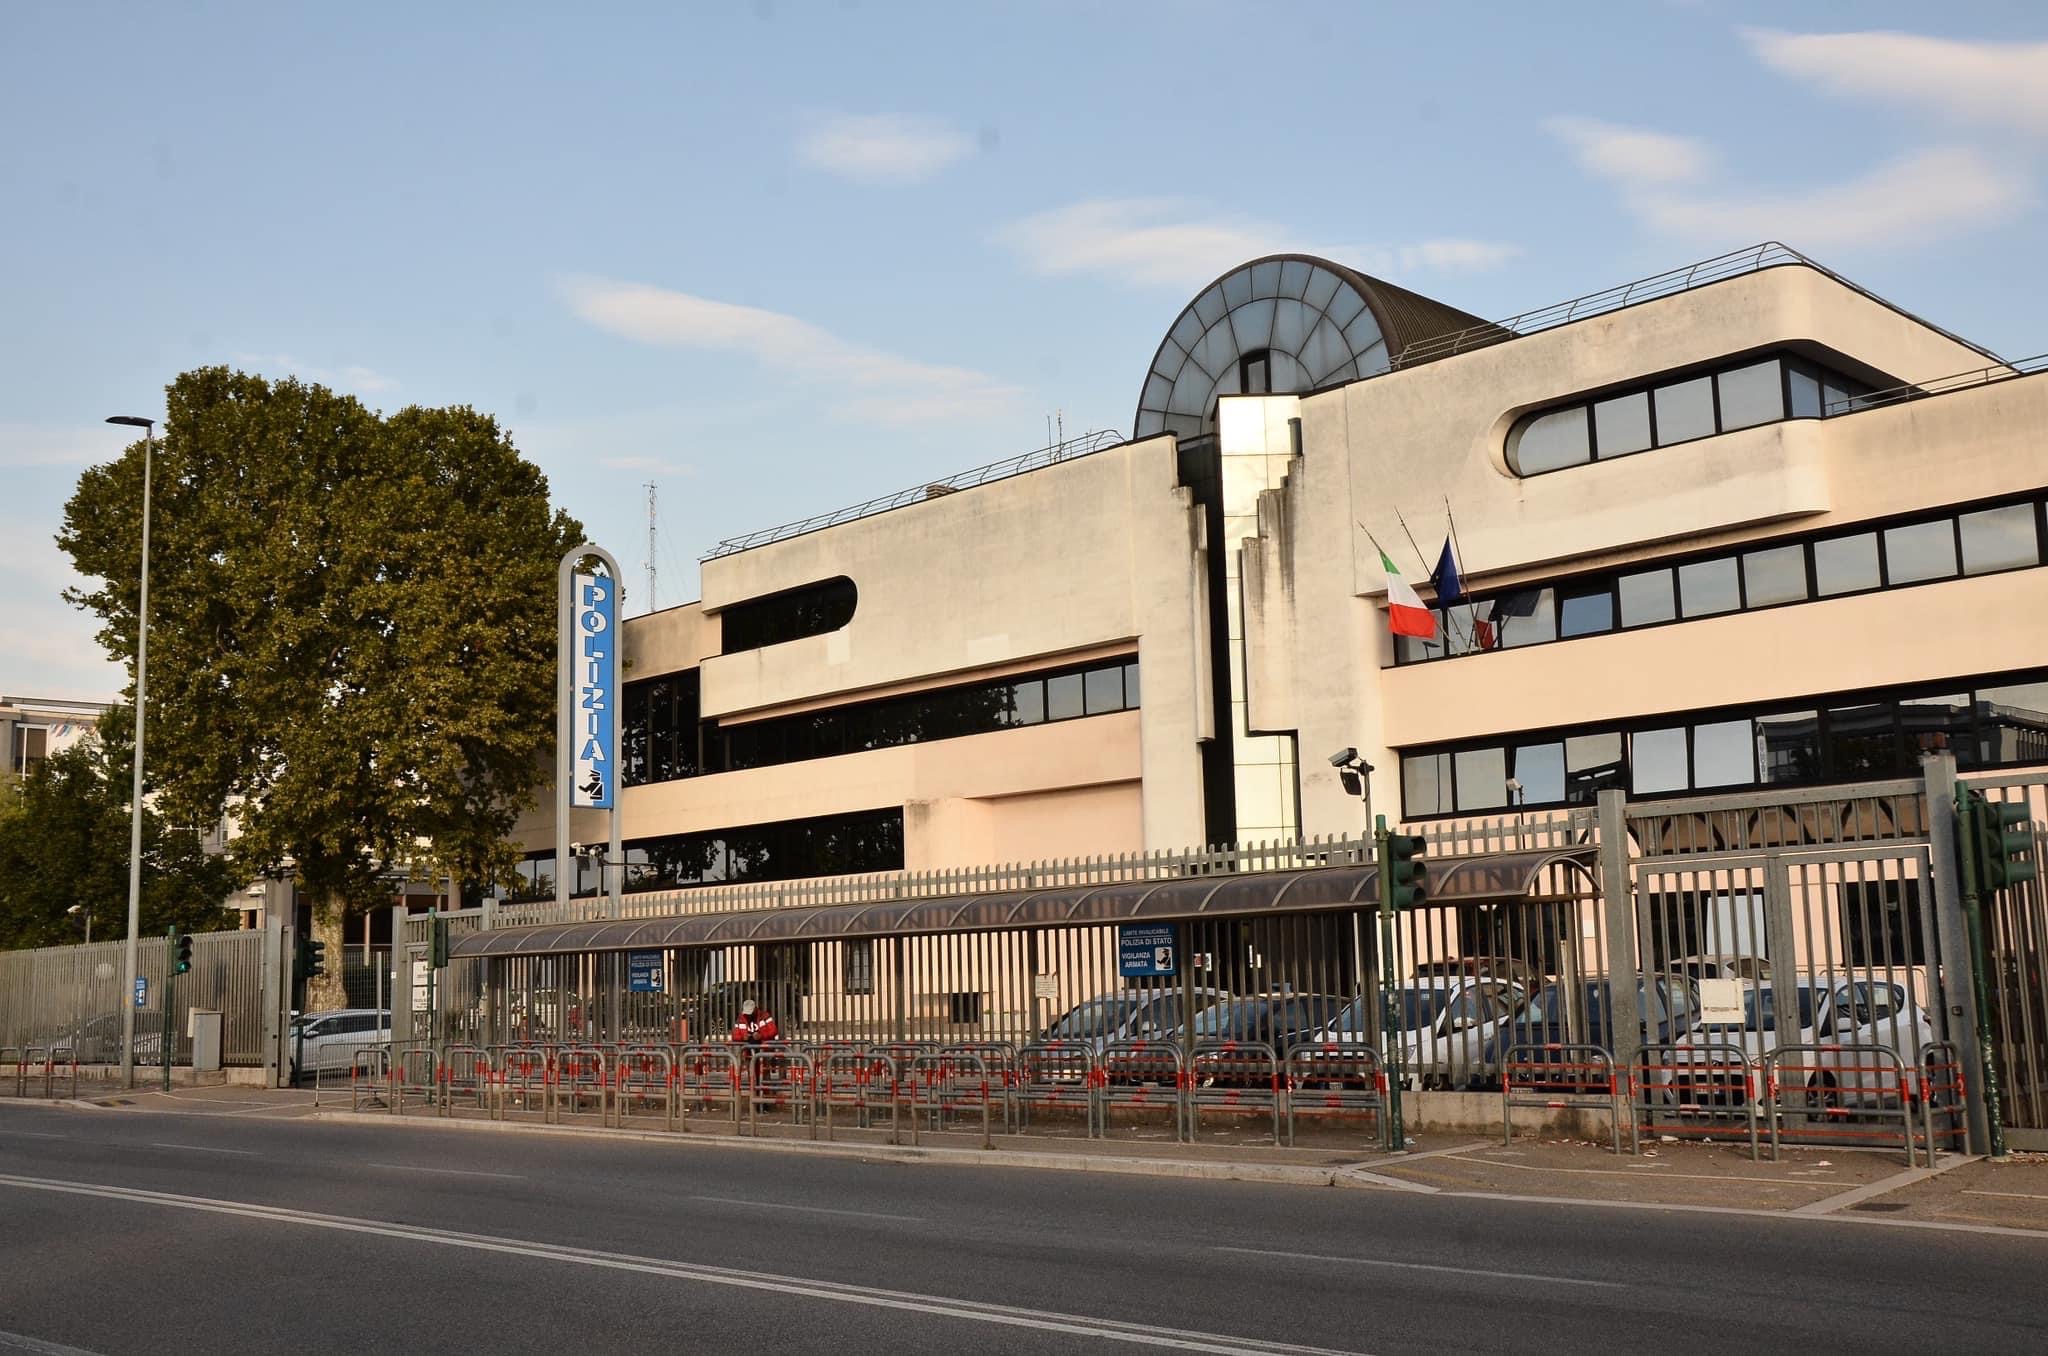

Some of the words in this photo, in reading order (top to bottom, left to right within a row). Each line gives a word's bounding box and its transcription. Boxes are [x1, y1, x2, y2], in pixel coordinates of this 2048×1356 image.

[581, 585, 607, 761] POLIZIA
[1152, 937, 1172, 945] STATO
[1121, 952, 1151, 960] VIGILANZA
